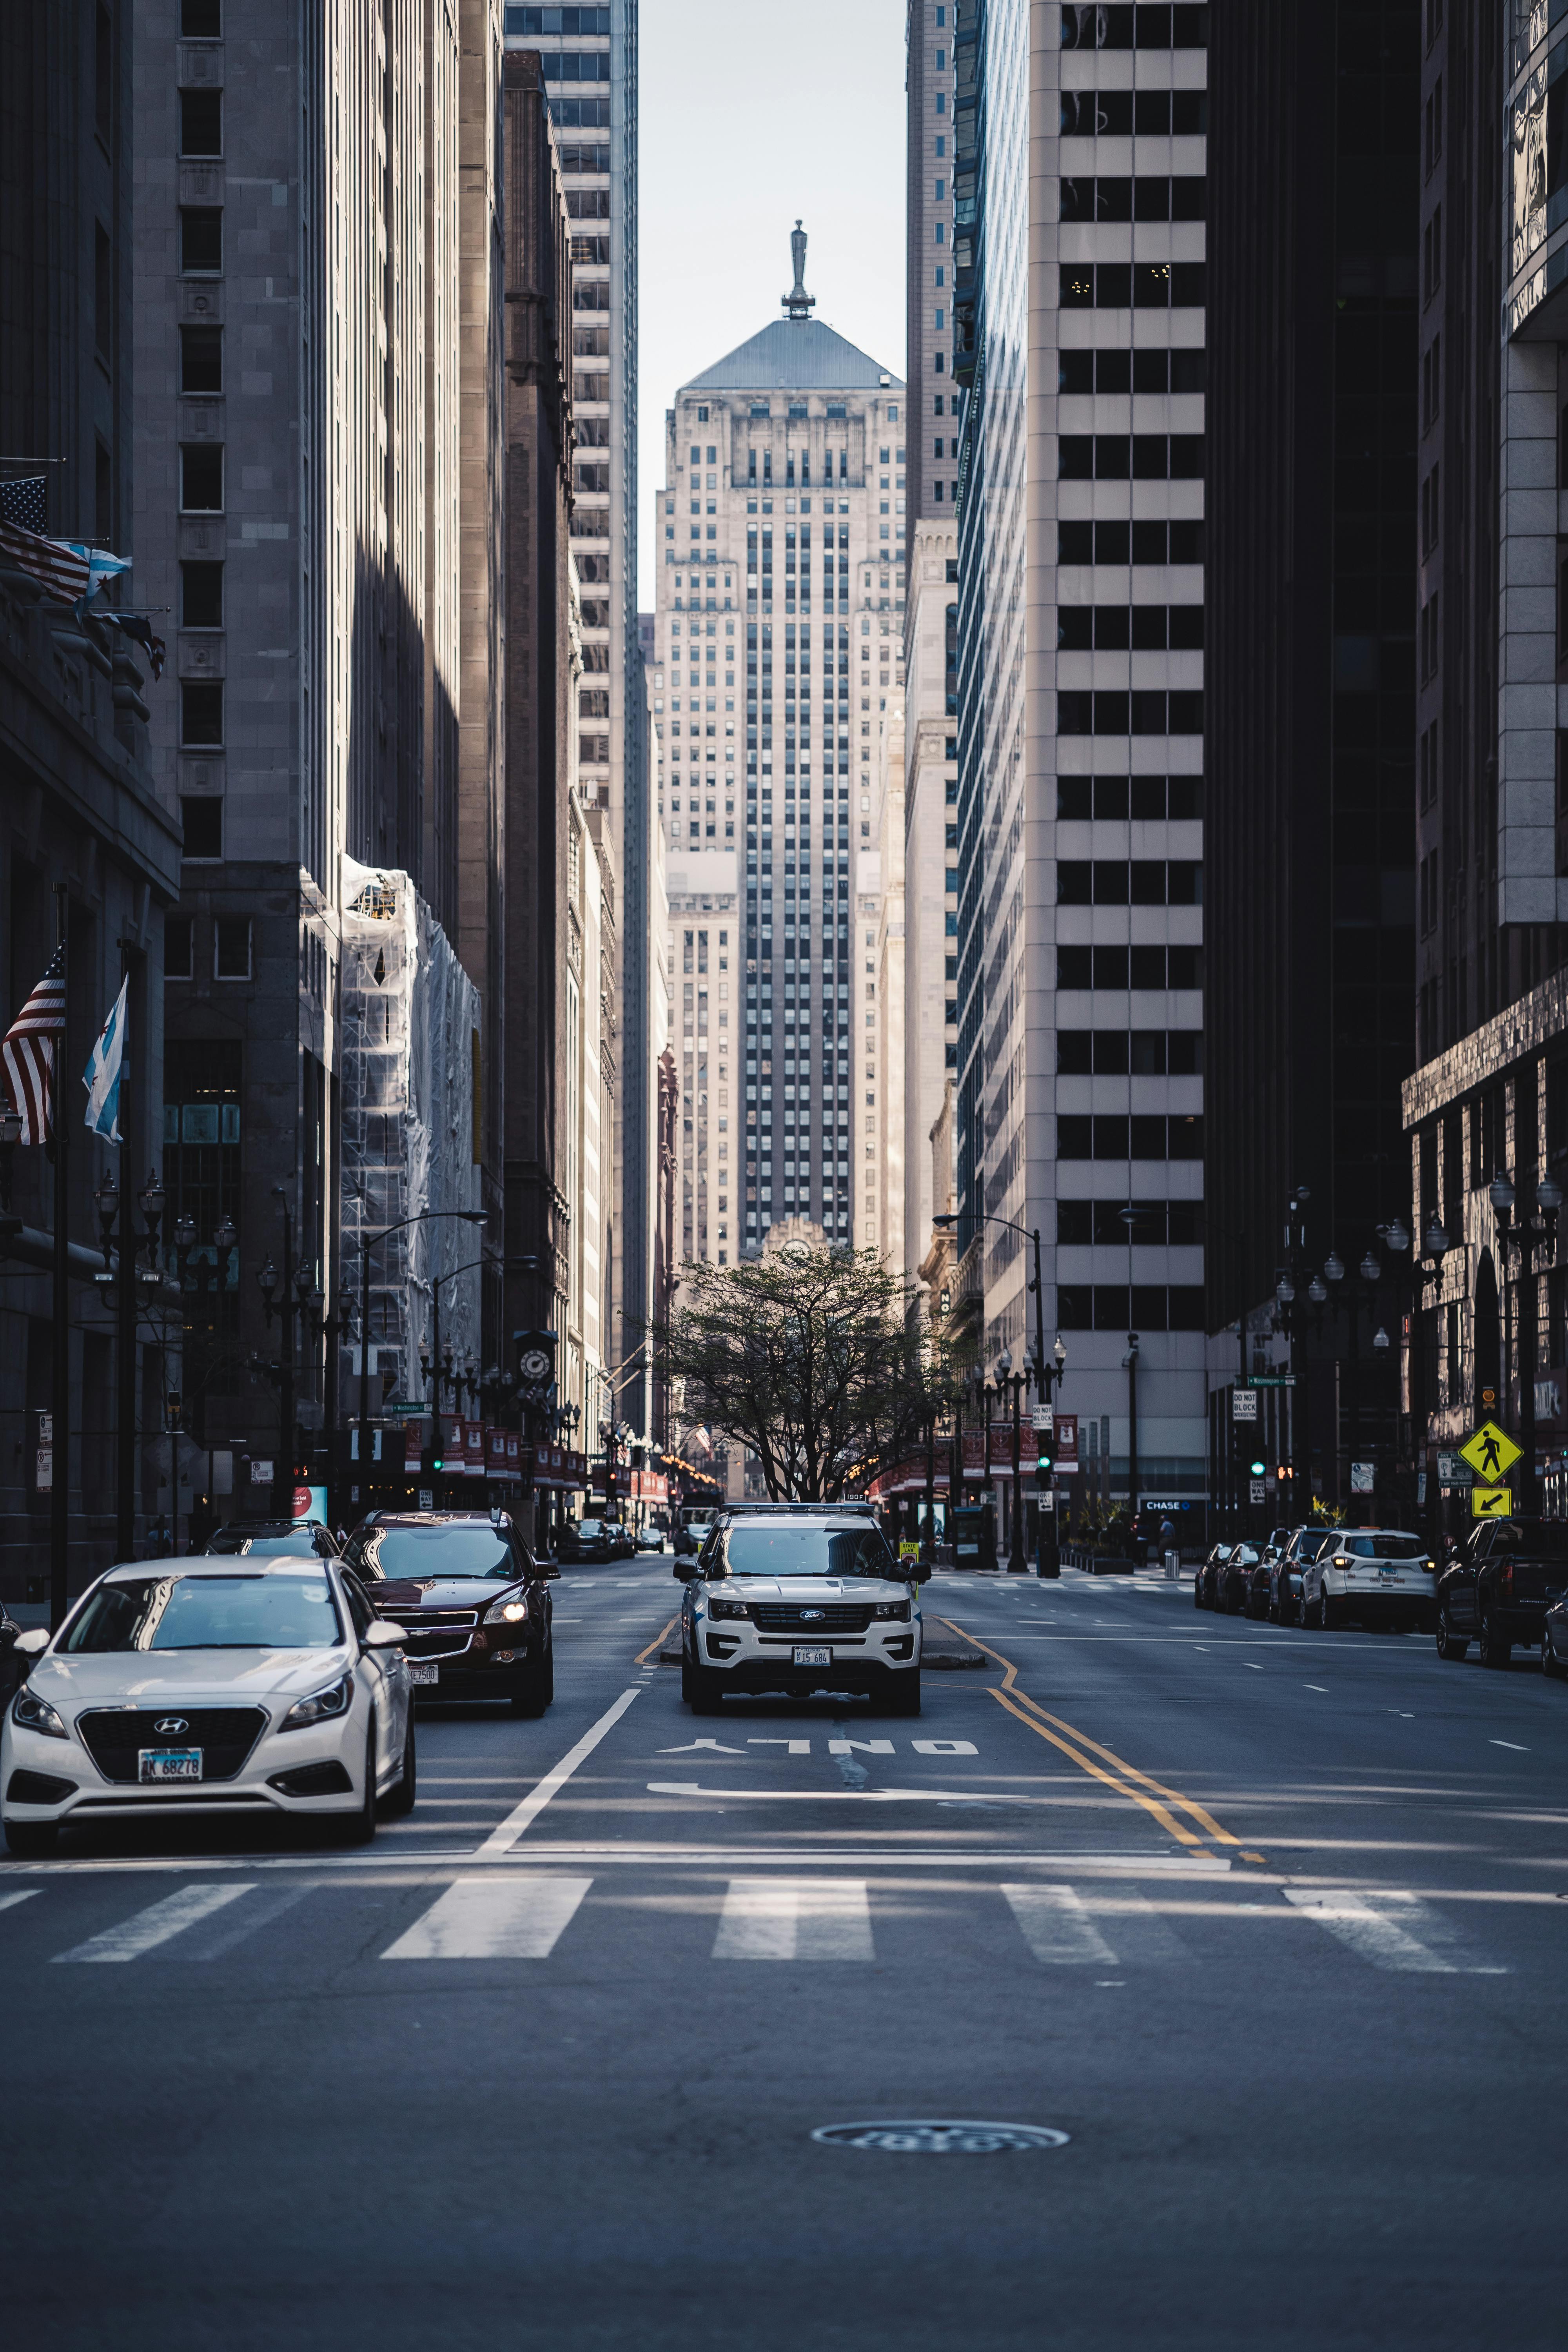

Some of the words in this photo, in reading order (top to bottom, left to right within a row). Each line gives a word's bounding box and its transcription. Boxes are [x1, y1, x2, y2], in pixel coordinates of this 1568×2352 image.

[1254, 1377, 1279, 1385] Washington
[1147, 1501, 1180, 1510] CHASE
[802, 1653, 810, 1662] 15
[814, 1653, 827, 1662] 684
[654, 1739, 979, 1755] ONLY
[163, 1759, 199, 1775] 68278
